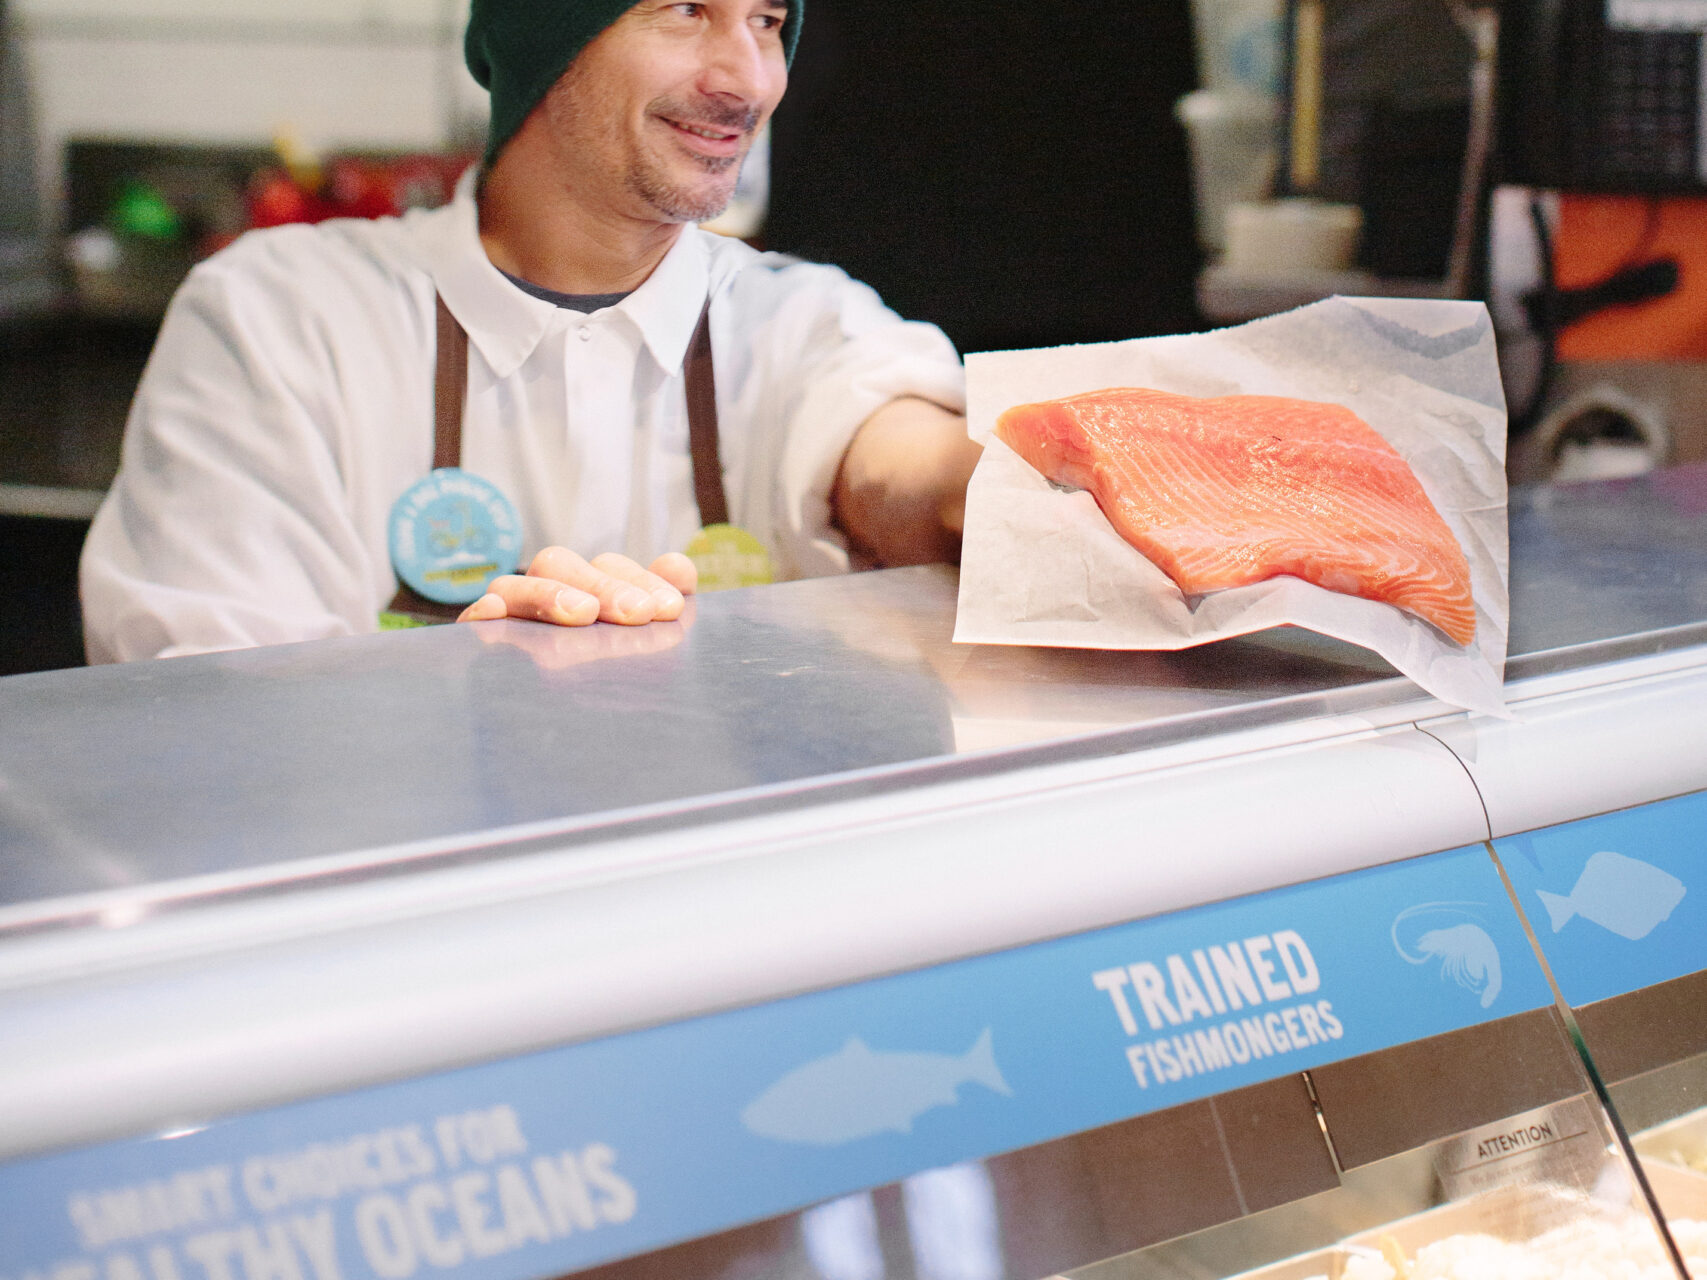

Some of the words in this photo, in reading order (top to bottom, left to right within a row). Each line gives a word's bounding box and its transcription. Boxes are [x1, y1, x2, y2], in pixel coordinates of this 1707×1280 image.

[1092, 929, 1321, 1037] TRAINED
[1125, 1000, 1344, 1090] FISHMONGERS
[243, 1122, 435, 1213] CHOICES
[434, 1104, 527, 1168] FOR
[1477, 1122, 1553, 1159] ATTENTION
[355, 1142, 637, 1279] OCEANS
